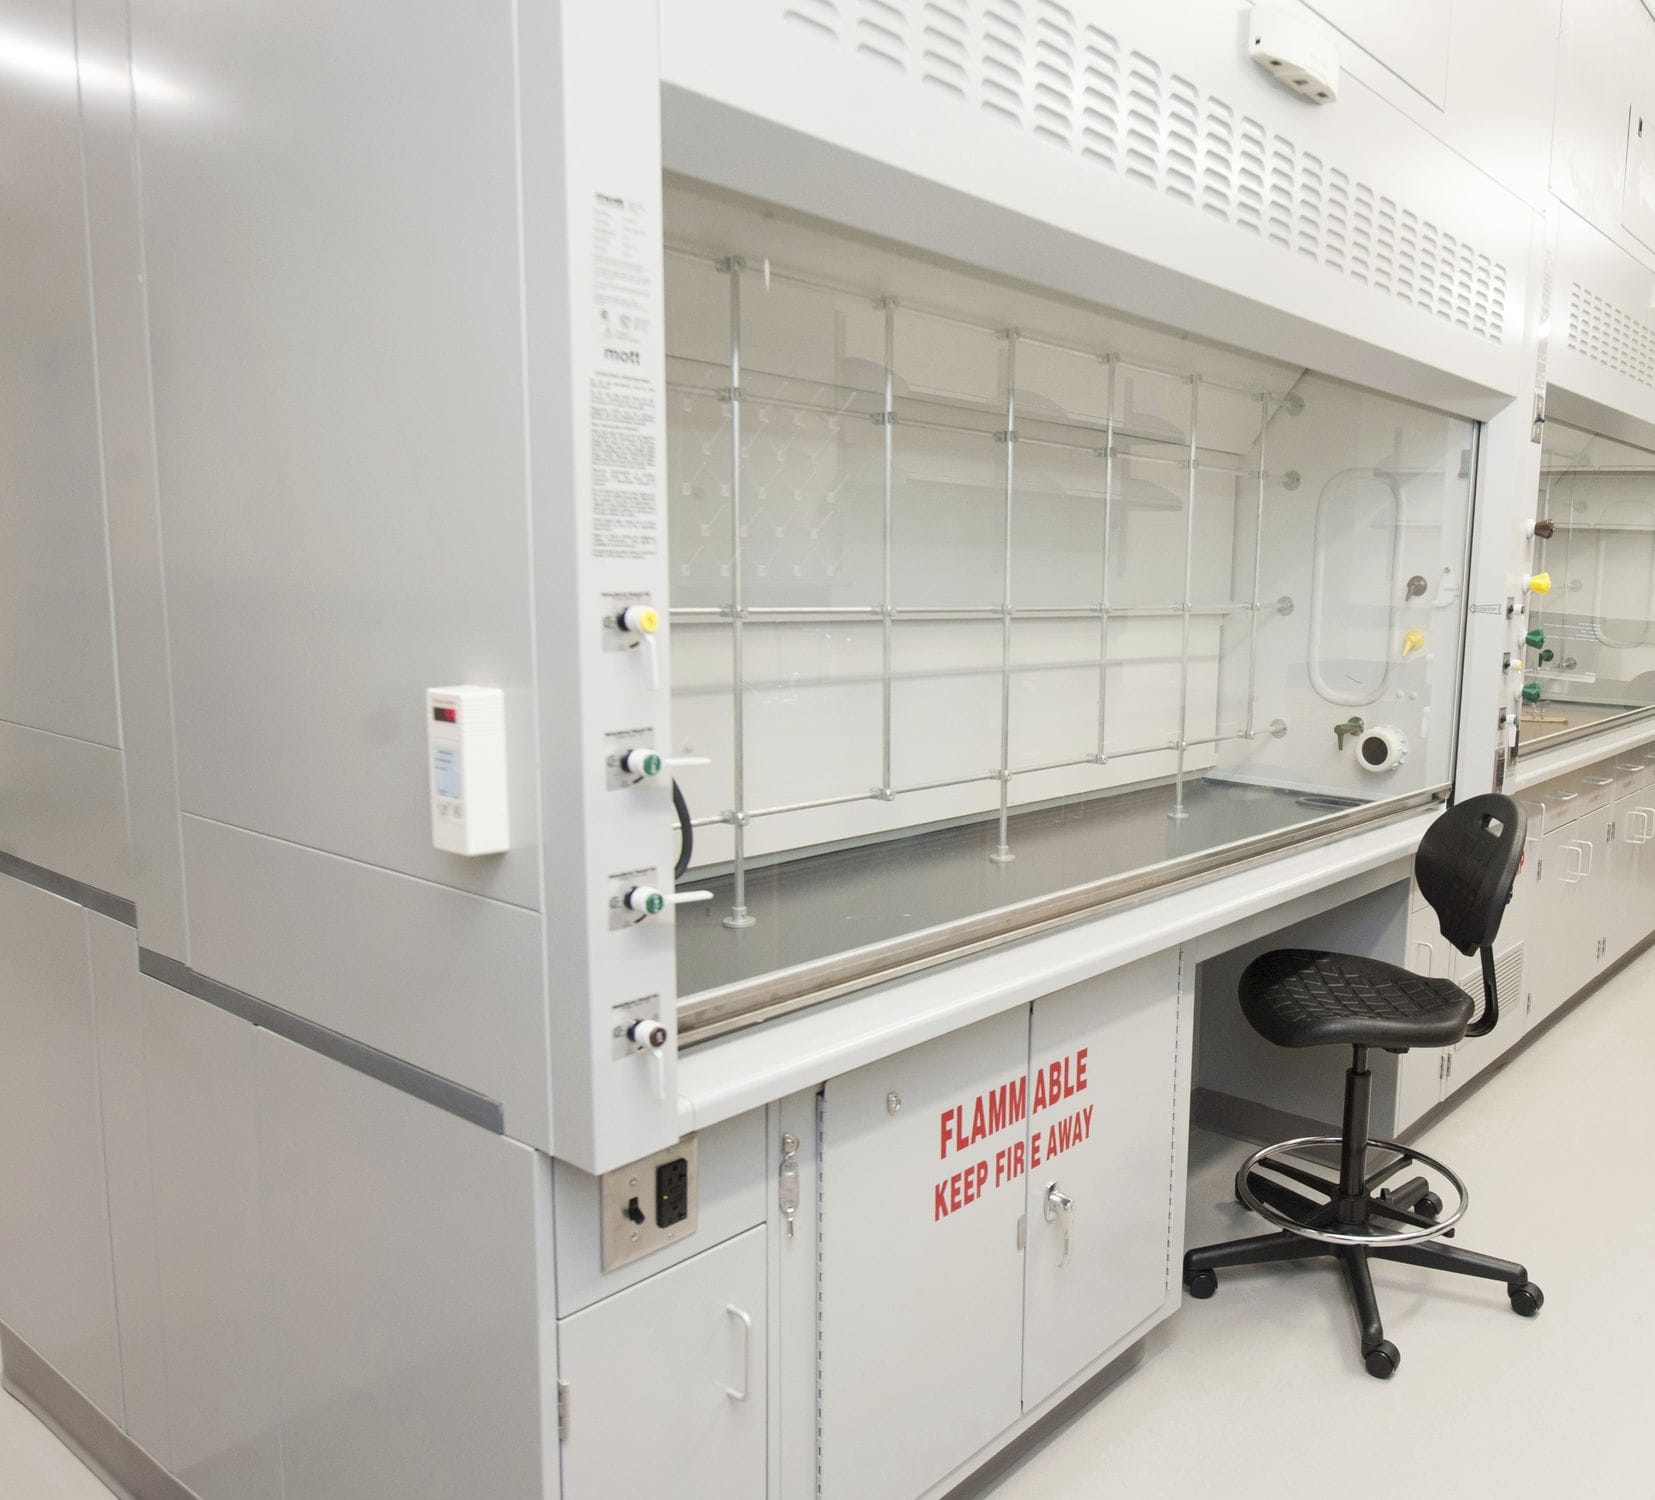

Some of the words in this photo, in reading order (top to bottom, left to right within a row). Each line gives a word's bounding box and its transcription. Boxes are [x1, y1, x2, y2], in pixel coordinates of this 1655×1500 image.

[604, 349, 641, 366] mott
[940, 1047, 1088, 1160] FLAMMABLE
[935, 1160, 989, 1222] KEEP
[995, 1131, 1042, 1188] FIRE
[1046, 1104, 1094, 1161] AWAY
